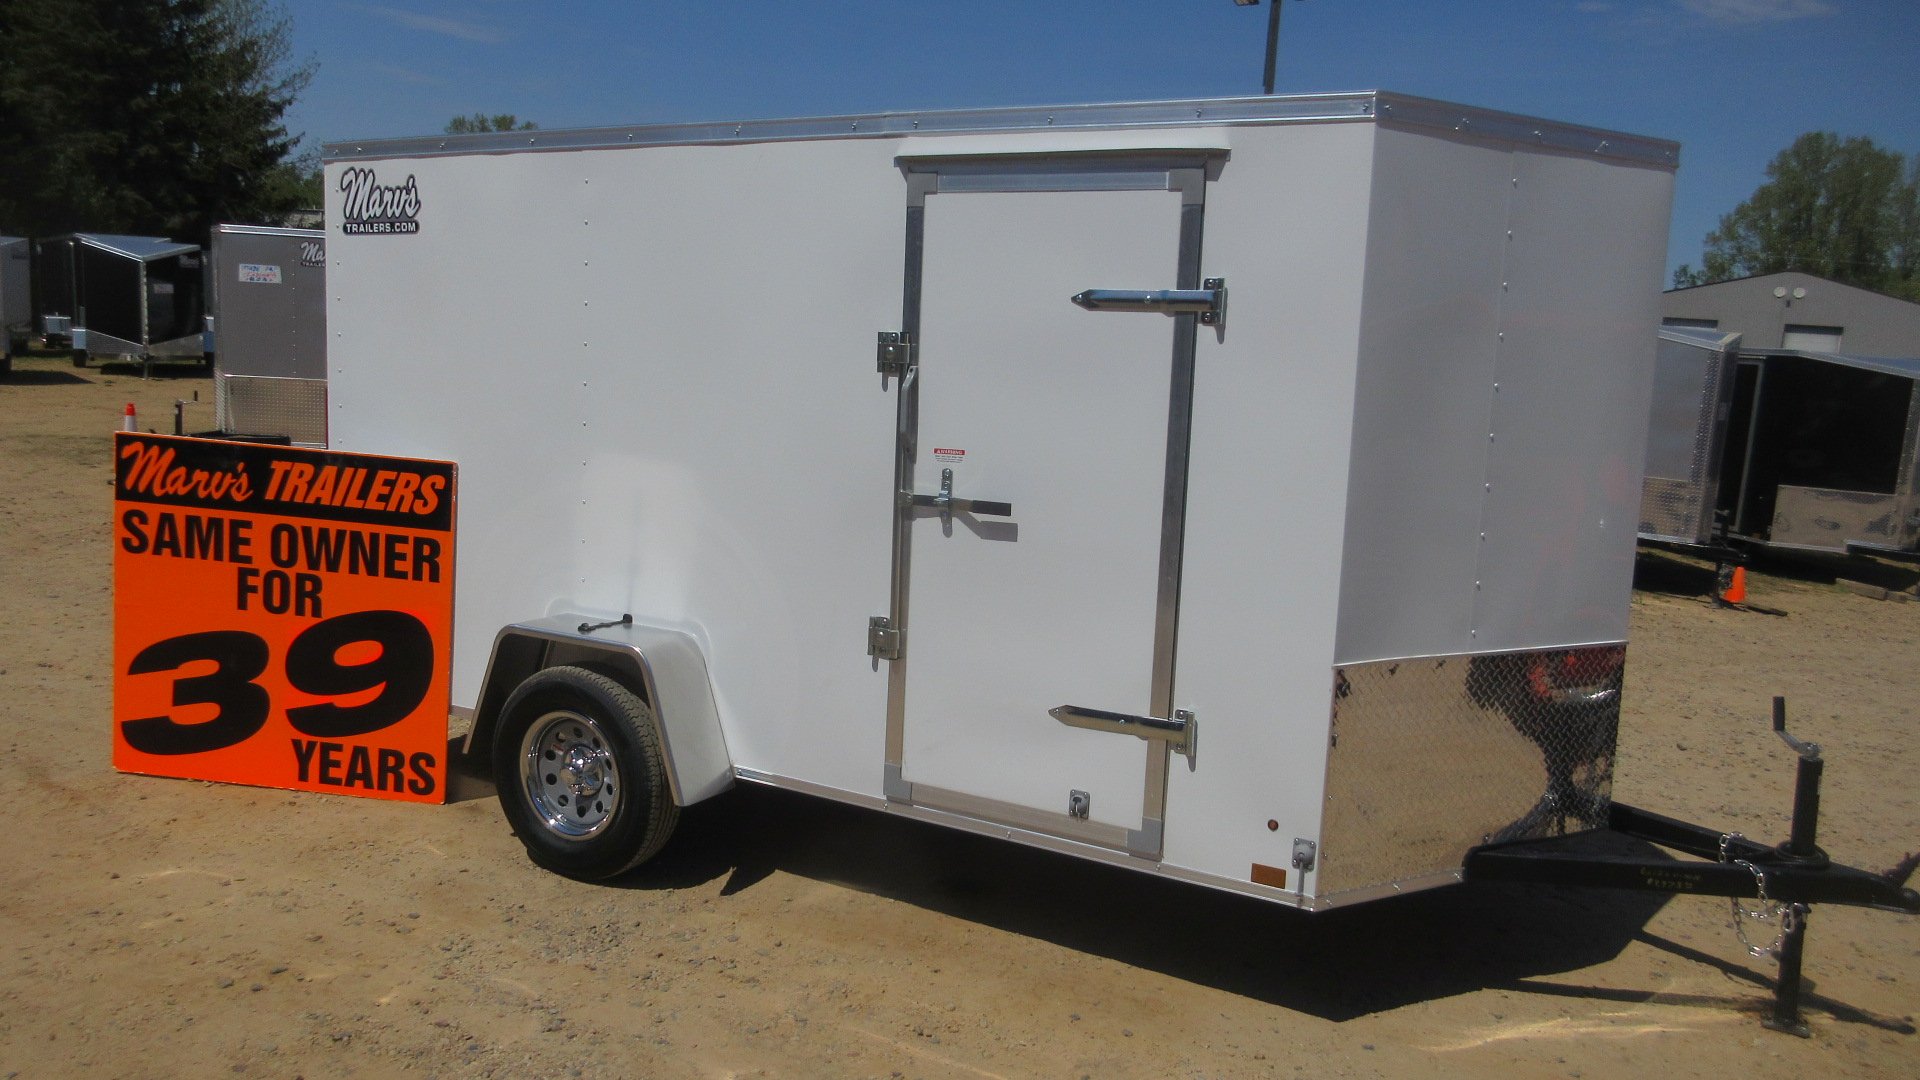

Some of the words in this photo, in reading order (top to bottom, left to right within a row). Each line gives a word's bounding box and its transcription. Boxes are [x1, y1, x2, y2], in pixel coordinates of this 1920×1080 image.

[341, 167, 420, 220] Marv's
[345, 222, 416, 233] TRAILERS.COM
[122, 442, 253, 501] Marv's
[264, 460, 445, 514] TRAILERS
[122, 509, 253, 565] SAME
[270, 523, 441, 583] OWNER
[237, 568, 323, 618] FOR
[121, 610, 434, 755] 39
[291, 739, 436, 796] YEARS
